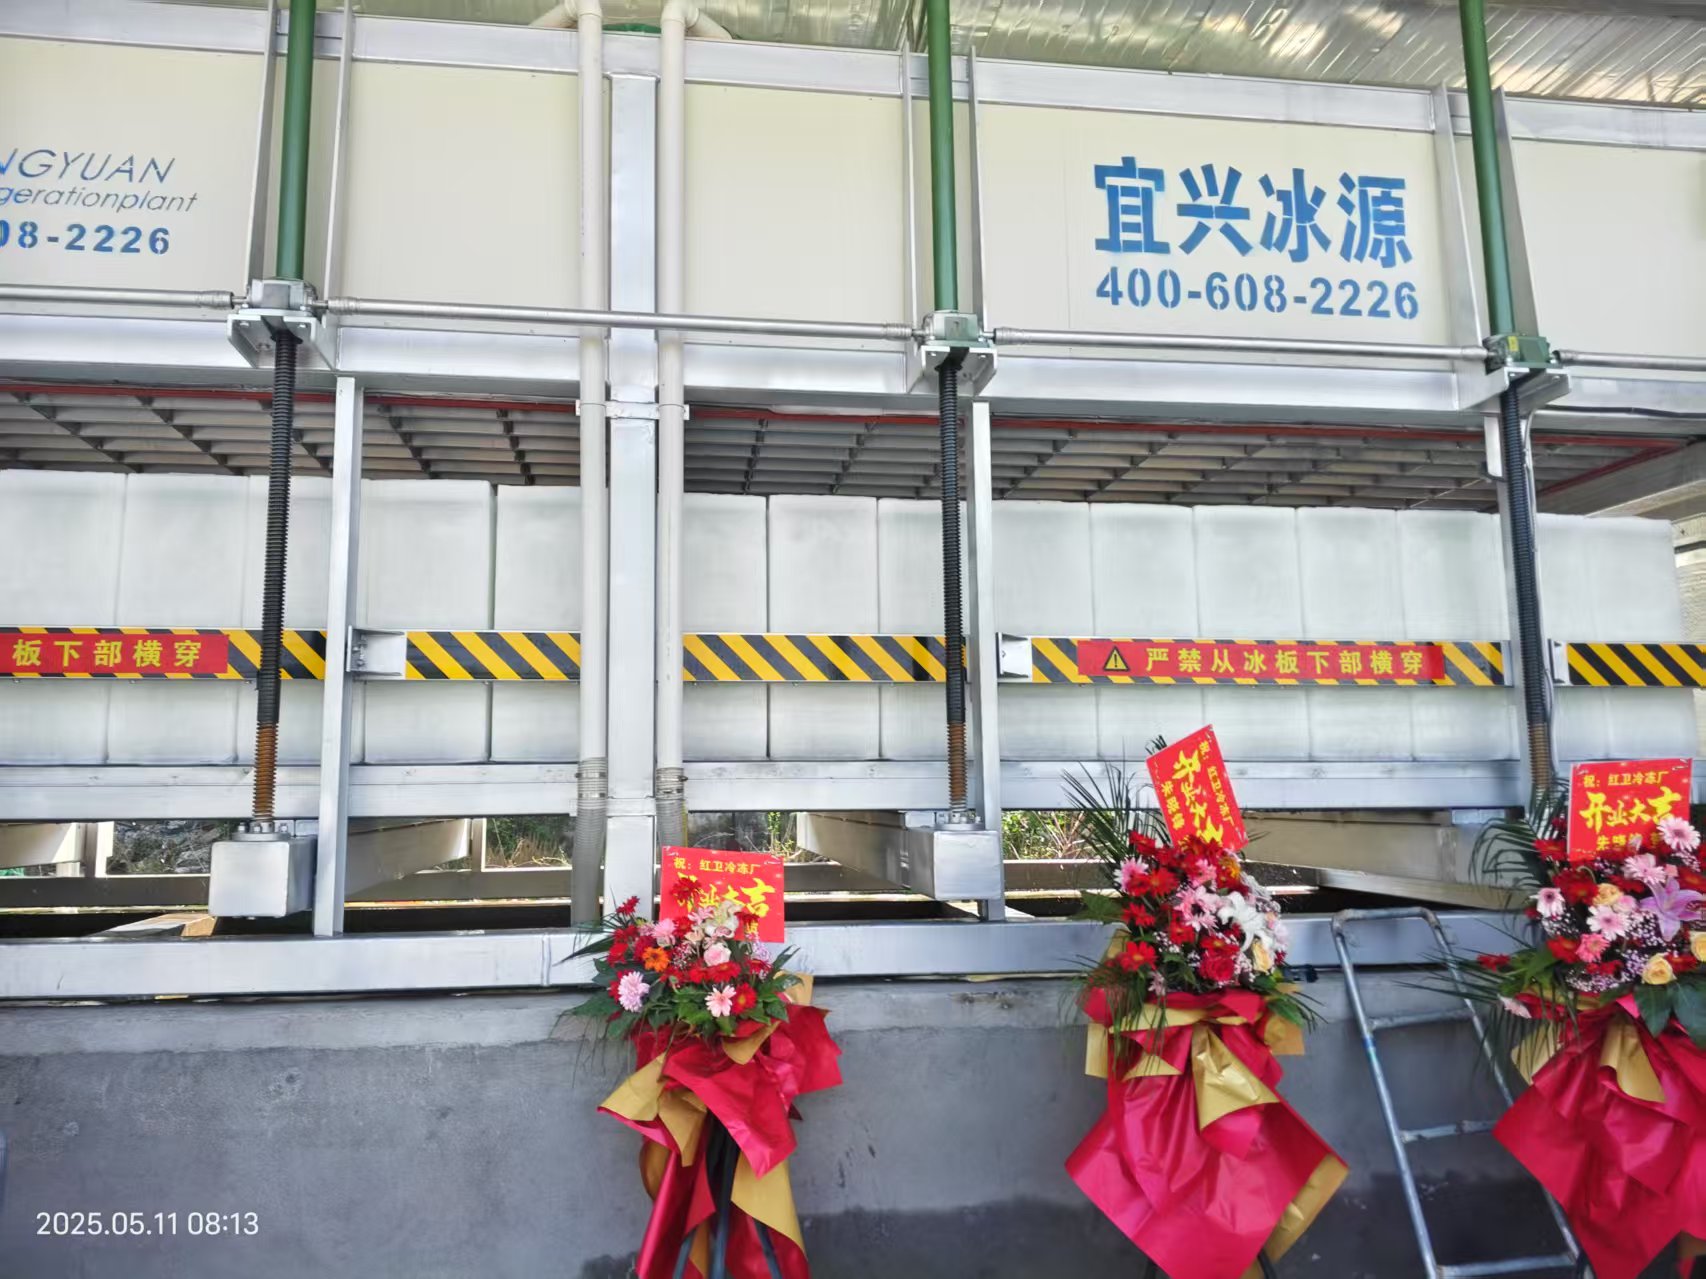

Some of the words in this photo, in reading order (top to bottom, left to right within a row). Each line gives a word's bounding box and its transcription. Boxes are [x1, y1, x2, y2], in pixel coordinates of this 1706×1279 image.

[1093, 156, 1413, 268] 宜兴冰源
[1096, 266, 1419, 320] 400-608-2226
[12, 639, 202, 668] 板下部横穿
[1145, 647, 1424, 676] 严禁从冰板下部横穿
[1607, 771, 1669, 786] 红卫冷冻厂
[700, 859, 761, 875] 红卫冷冻厂
